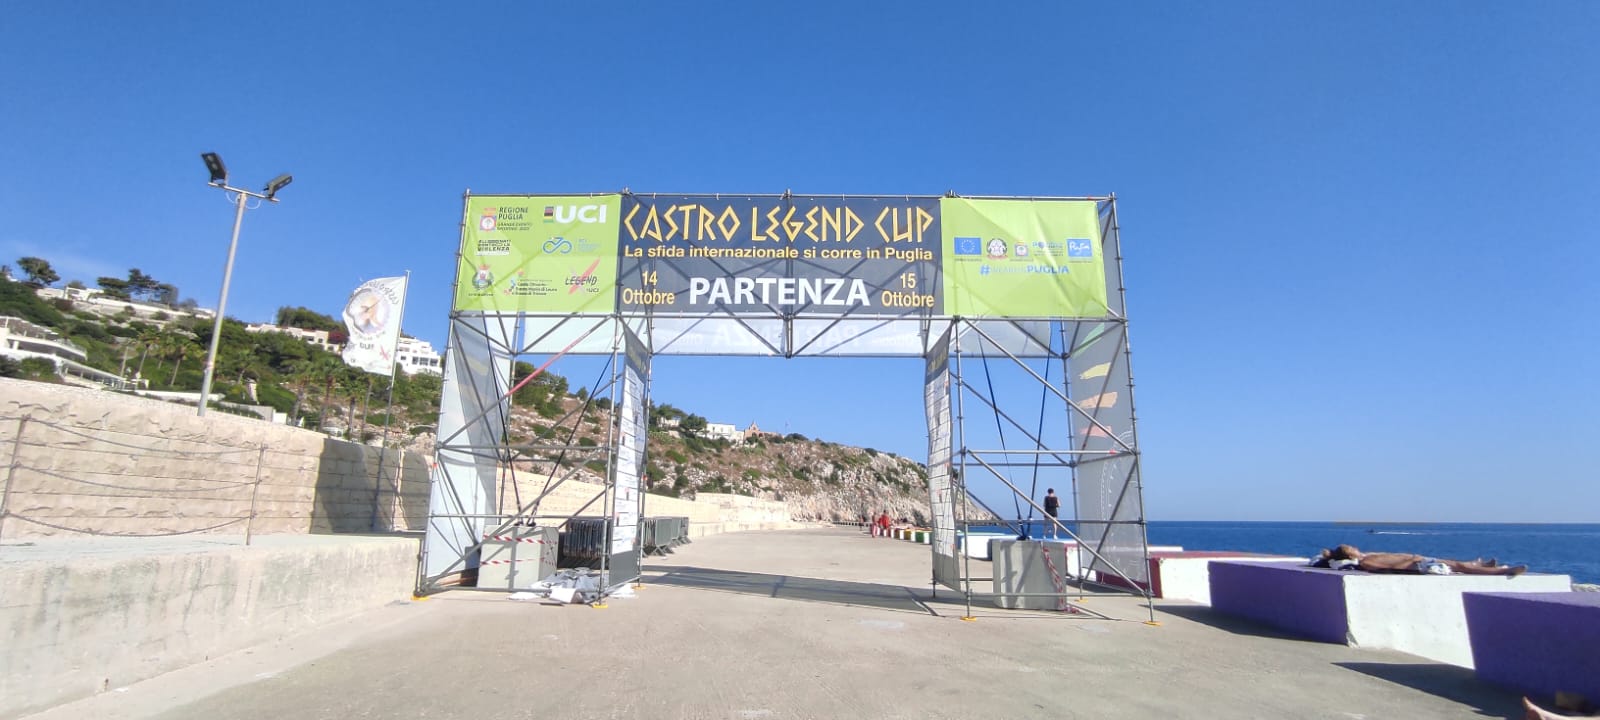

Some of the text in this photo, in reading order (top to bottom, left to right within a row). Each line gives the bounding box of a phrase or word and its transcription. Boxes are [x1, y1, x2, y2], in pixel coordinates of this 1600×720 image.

[556, 205, 607, 223] UCI
[624, 203, 934, 243] CASTRO LEGEND CUP
[625, 245, 933, 262] La sfida internazionale si corre in Puglia
[565, 274, 598, 285] LEGEND
[642, 270, 658, 286] 14
[900, 272, 916, 289] 15
[622, 287, 675, 305] Ottobre
[689, 276, 871, 306] PARTENZA
[881, 290, 935, 307] Ottobre
